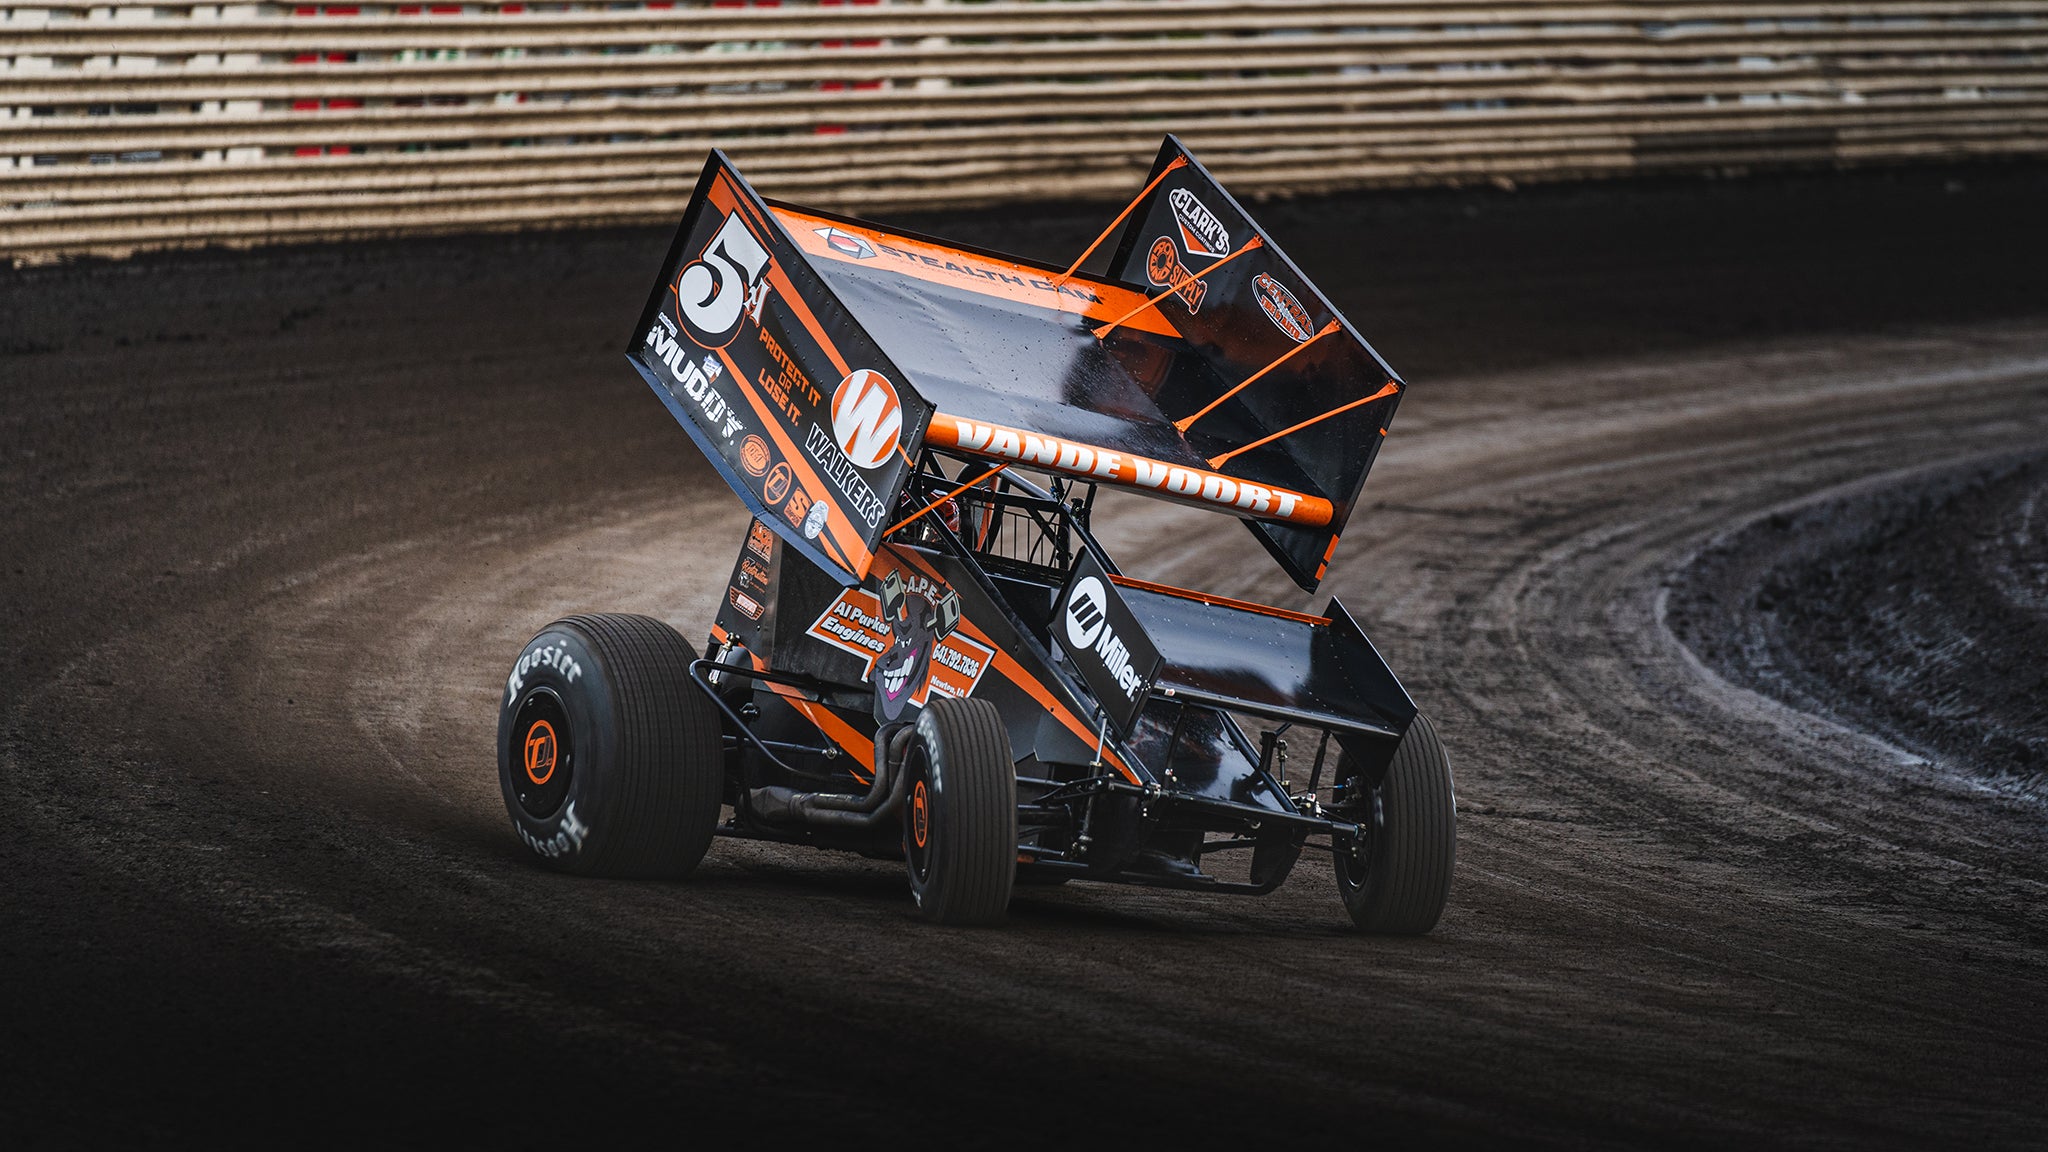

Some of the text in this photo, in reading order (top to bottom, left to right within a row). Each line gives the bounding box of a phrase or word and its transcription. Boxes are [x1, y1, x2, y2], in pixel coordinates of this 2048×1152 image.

[1174, 191, 1228, 251] CLARK'S
[1178, 213, 1196, 234] CUSTOM
[877, 243, 1025, 287] STEALTH
[1028, 279, 1103, 305] CAM
[1257, 272, 1311, 334] CENTRAL
[758, 367, 803, 427] LOSE IT.
[759, 326, 822, 408] PROTECT IT
[778, 371, 792, 394] OR
[805, 422, 886, 529] WALKER'S
[955, 421, 1303, 518] VANDE VOORT
[820, 616, 886, 654] Engines
[849, 606, 892, 637] Parker
[508, 640, 582, 708] Hoosier
[931, 642, 980, 679] 641.792.7836
[1095, 623, 1142, 698] Miller
